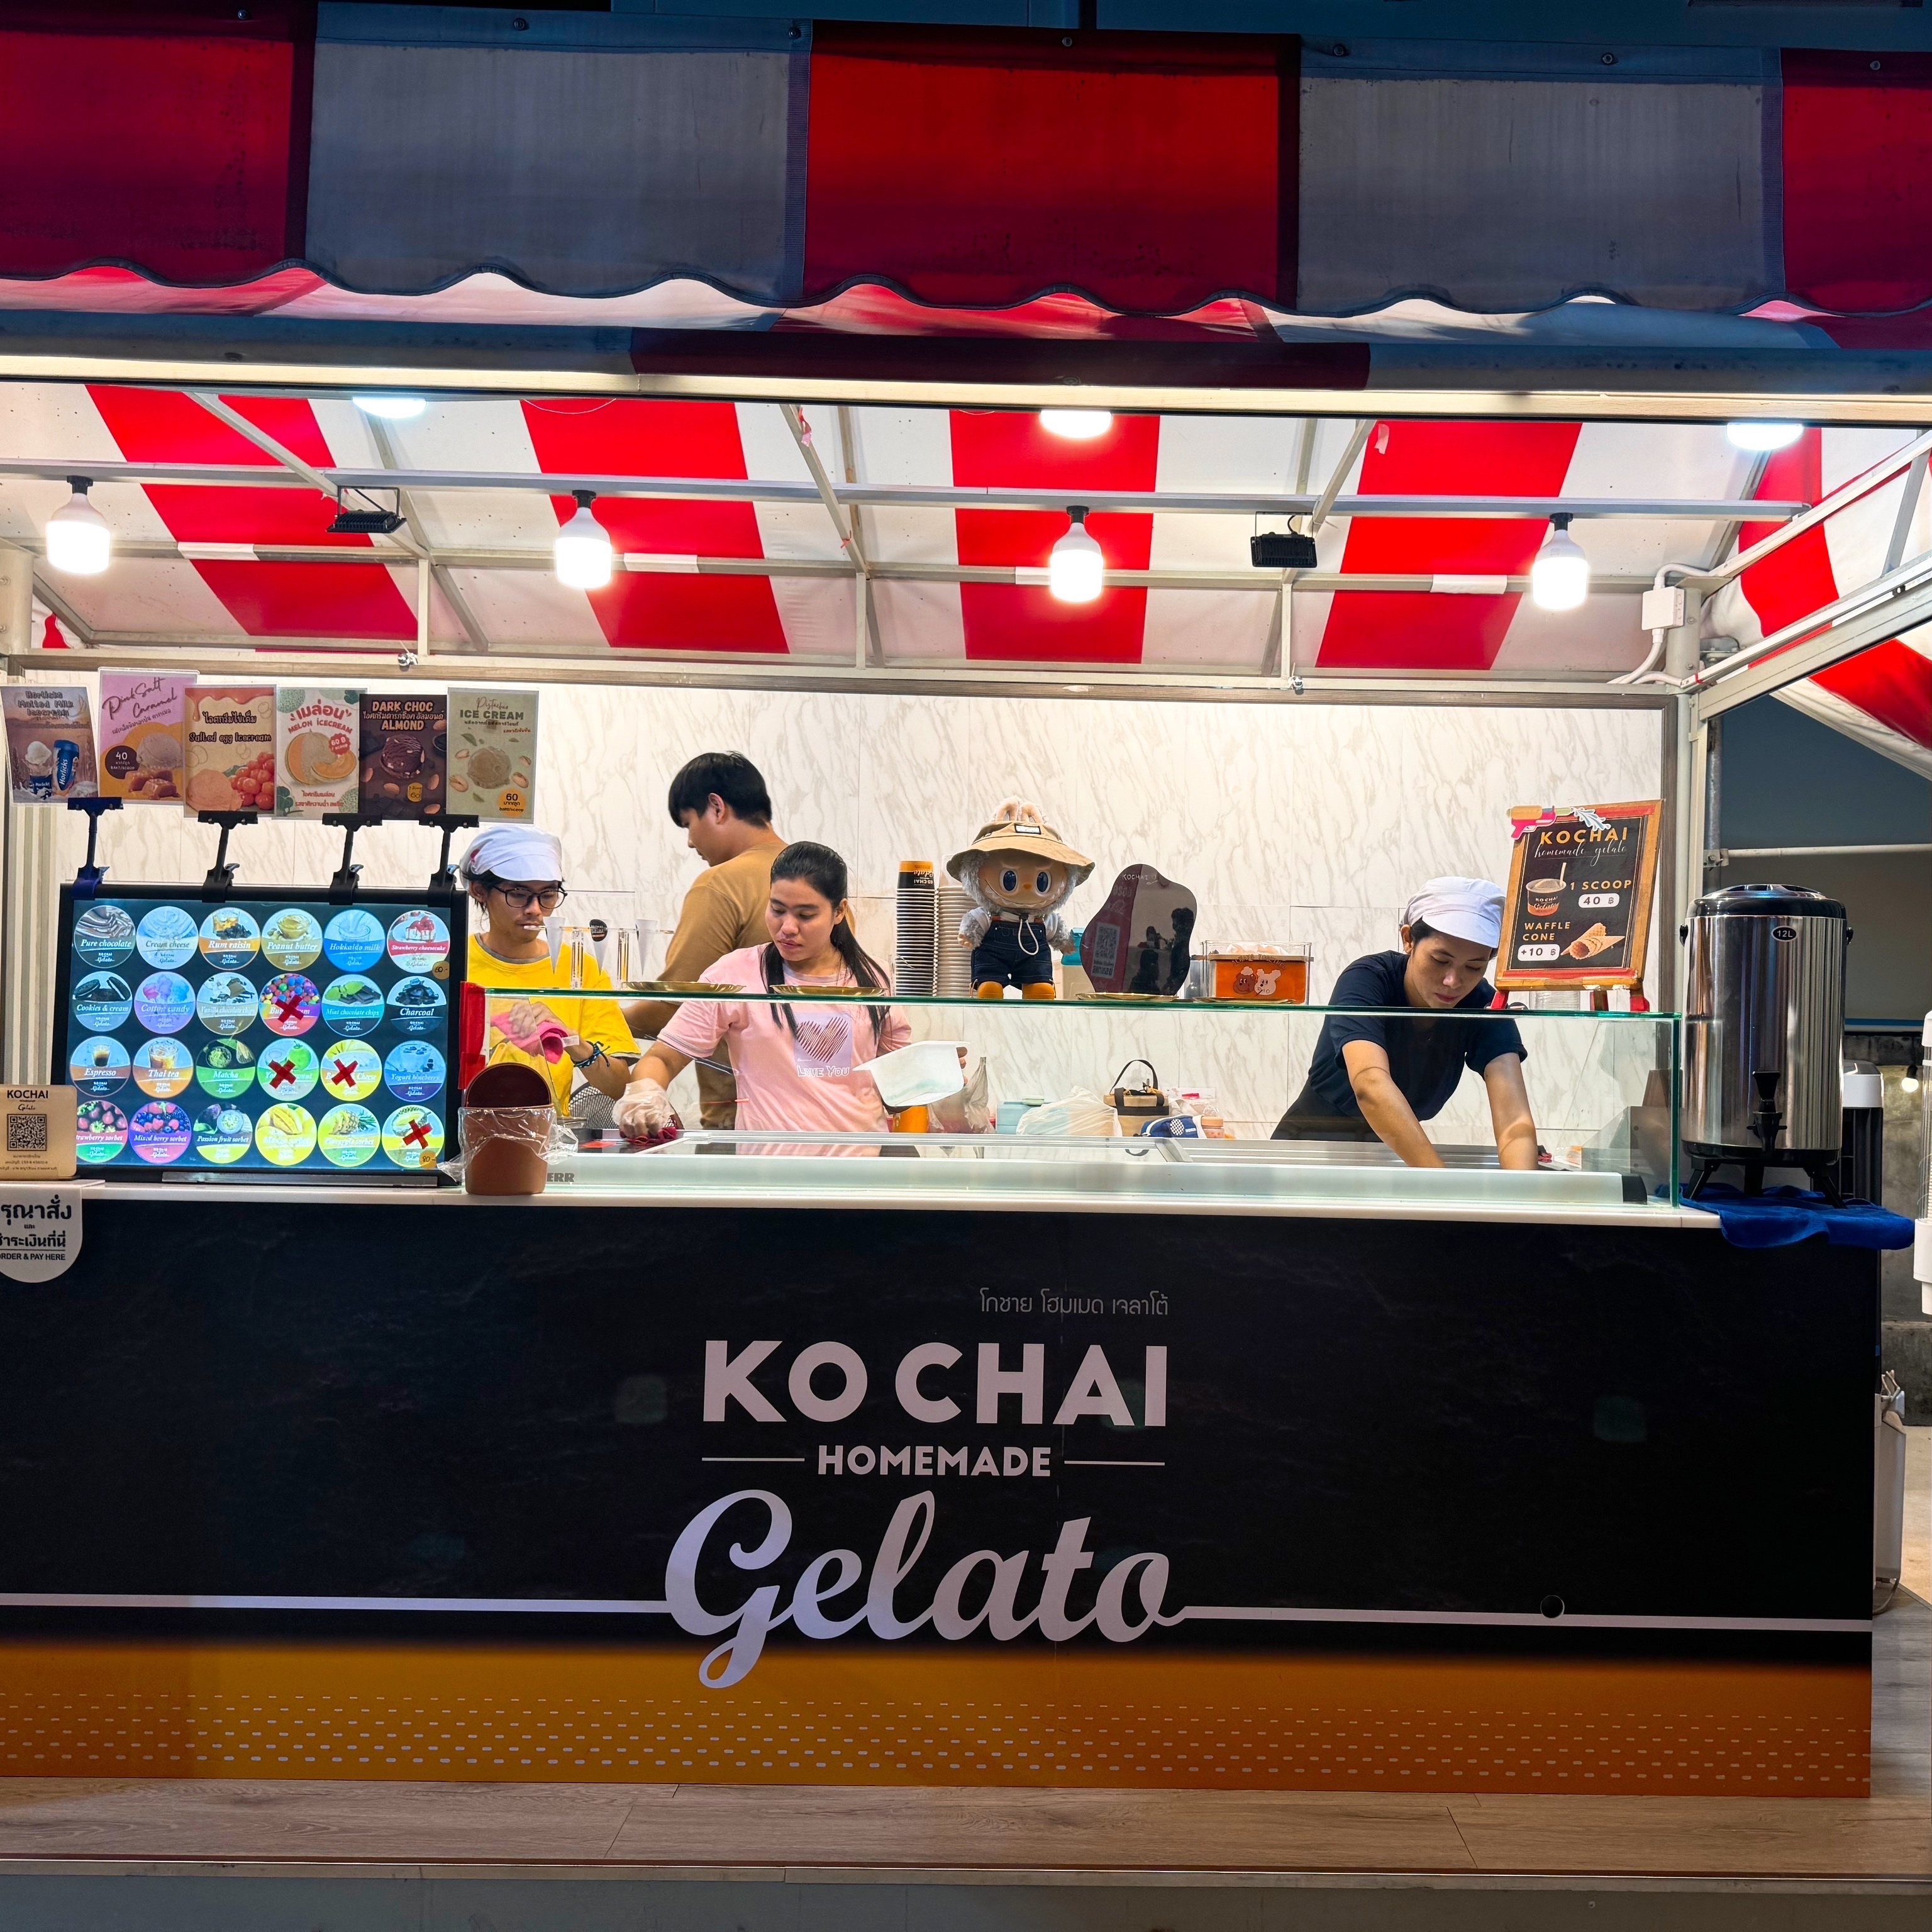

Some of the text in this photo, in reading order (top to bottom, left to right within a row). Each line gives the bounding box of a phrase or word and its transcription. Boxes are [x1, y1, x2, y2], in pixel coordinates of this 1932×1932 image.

[18, 700, 50, 708] Malted
[102, 677, 165, 720] Pink Salt
[133, 687, 177, 718] Caramel
[296, 699, 345, 720] เมล่อน
[372, 701, 433, 712] DARK CHOC
[460, 709, 524, 720] ICE CREAM
[288, 720, 313, 733] MELON
[381, 719, 425, 730] ALMOND
[189, 731, 272, 744] Salted egg Icecream
[116, 752, 127, 760] 40
[59, 758, 68, 785] Horlicks
[1541, 827, 1628, 844] KOCHAI
[1535, 838, 1627, 867] homemade gelato
[1570, 880, 1631, 891] 1 SCOOP
[1584, 896, 1601, 905] 40
[1524, 922, 1570, 930] WAFFLE
[80, 939, 132, 947] Pure chocolate
[208, 940, 251, 949] Rum raisin
[267, 941, 318, 950] Peanut butter
[1521, 948, 1543, 957] +10
[77, 1004, 101, 1012] Cookies
[102, 1004, 108, 1012] &
[167, 1005, 190, 1013] candy
[365, 1009, 379, 1017] chips
[84, 1068, 116, 1077] Espresso
[148, 1069, 166, 1077] Thai
[391, 1074, 411, 1082] Yogurt
[7, 1090, 48, 1099] KOCHAI
[18, 1103, 35, 1111] Gelato
[0, 1230, 65, 1247] ำระเงินที่นี่
[980, 1287, 1169, 1315] โกชาย โฮมเมด เจลาโต้
[702, 1340, 1167, 1426] KO CHAI
[818, 1445, 1050, 1477] HOMEMADE
[665, 1489, 1181, 1689] Gelato
